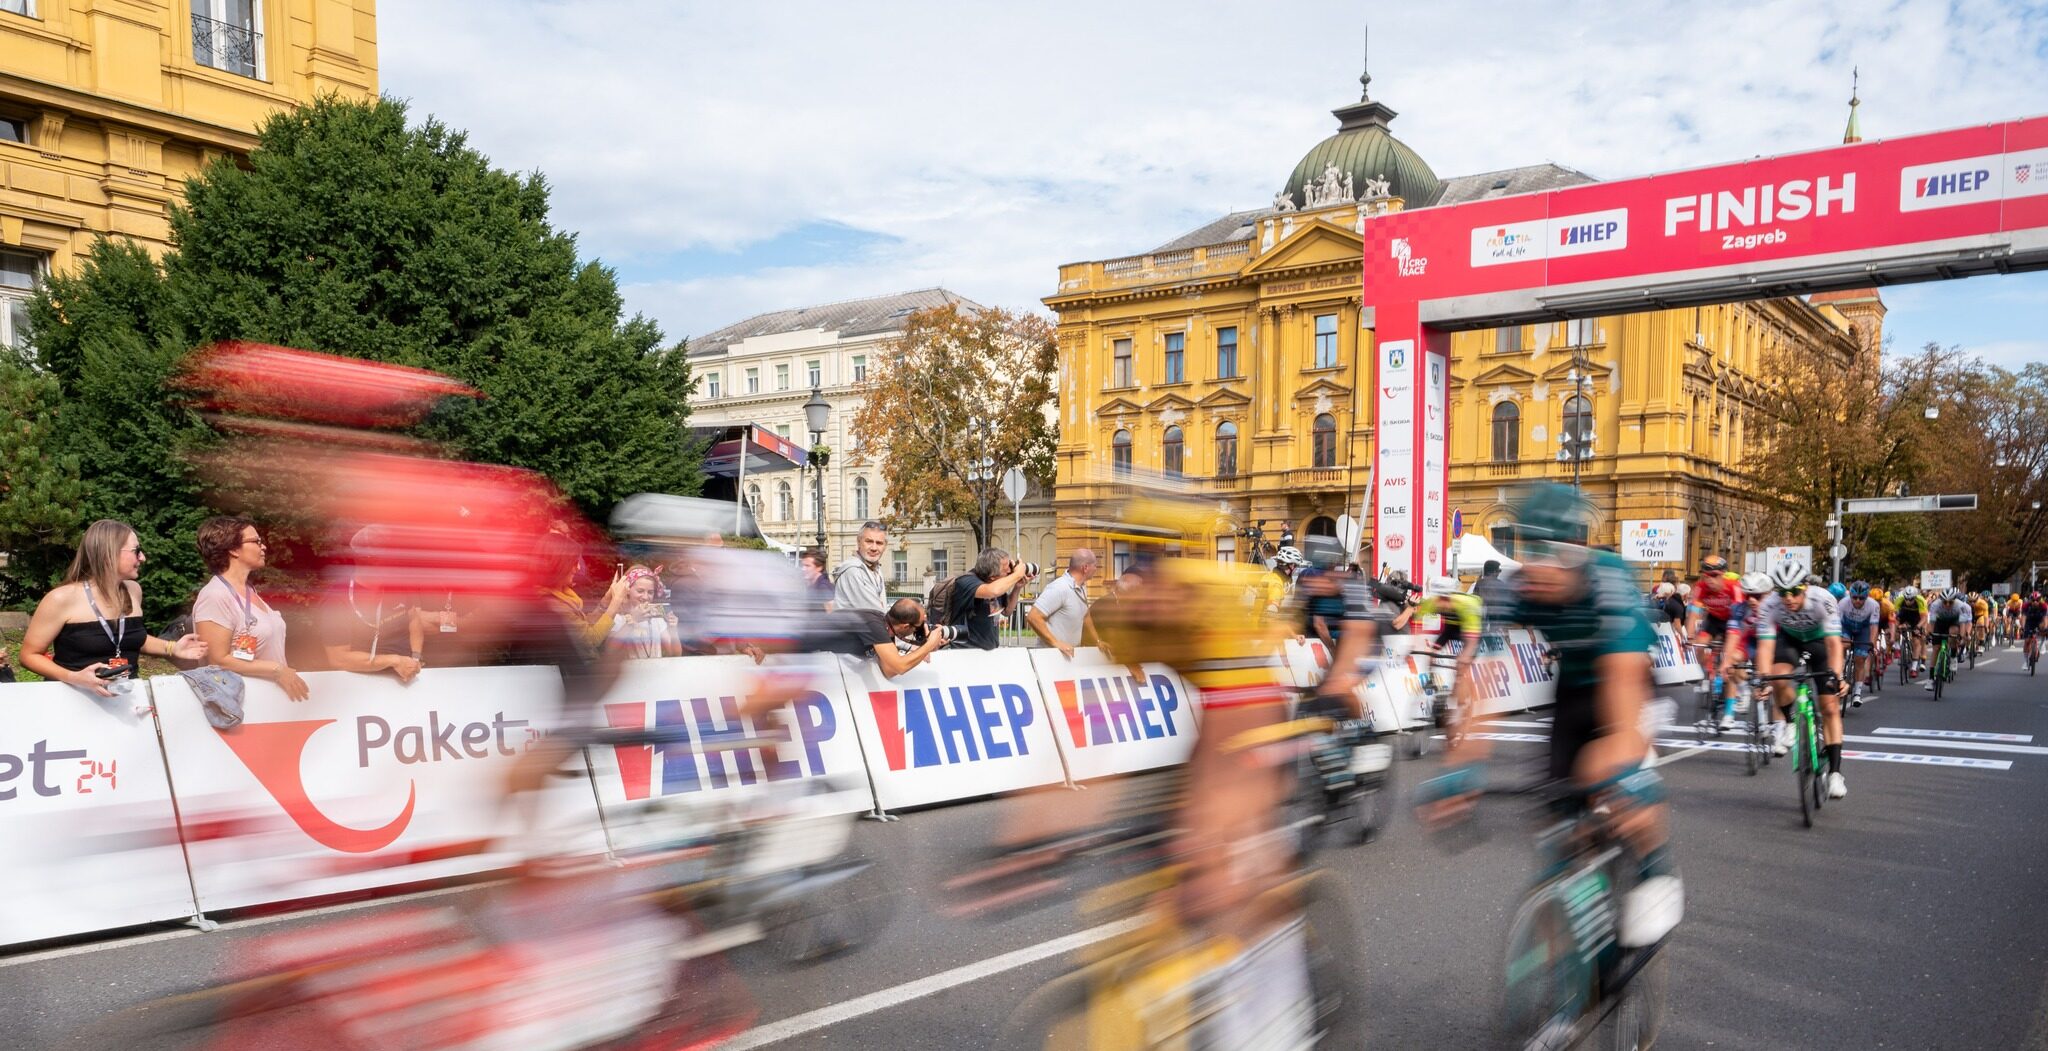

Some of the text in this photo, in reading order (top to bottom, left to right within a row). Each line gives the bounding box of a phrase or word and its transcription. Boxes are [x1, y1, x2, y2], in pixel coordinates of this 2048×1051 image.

[1940, 169, 1990, 195] HEP
[1664, 172, 1857, 237] FINISH
[1579, 222, 1618, 243] HEP
[1721, 229, 1788, 250] Zagreb
[1402, 265, 1426, 277] RACE
[1409, 257, 1428, 268] CRO
[1384, 477, 1407, 487] AVIS
[1640, 548, 1664, 558] 10m
[1477, 660, 1511, 699] HEP
[1098, 673, 1181, 742] HEP
[928, 683, 1034, 764] HEP
[357, 710, 530, 768] Paket
[690, 690, 838, 790] HEP
[76, 759, 117, 794] 24
